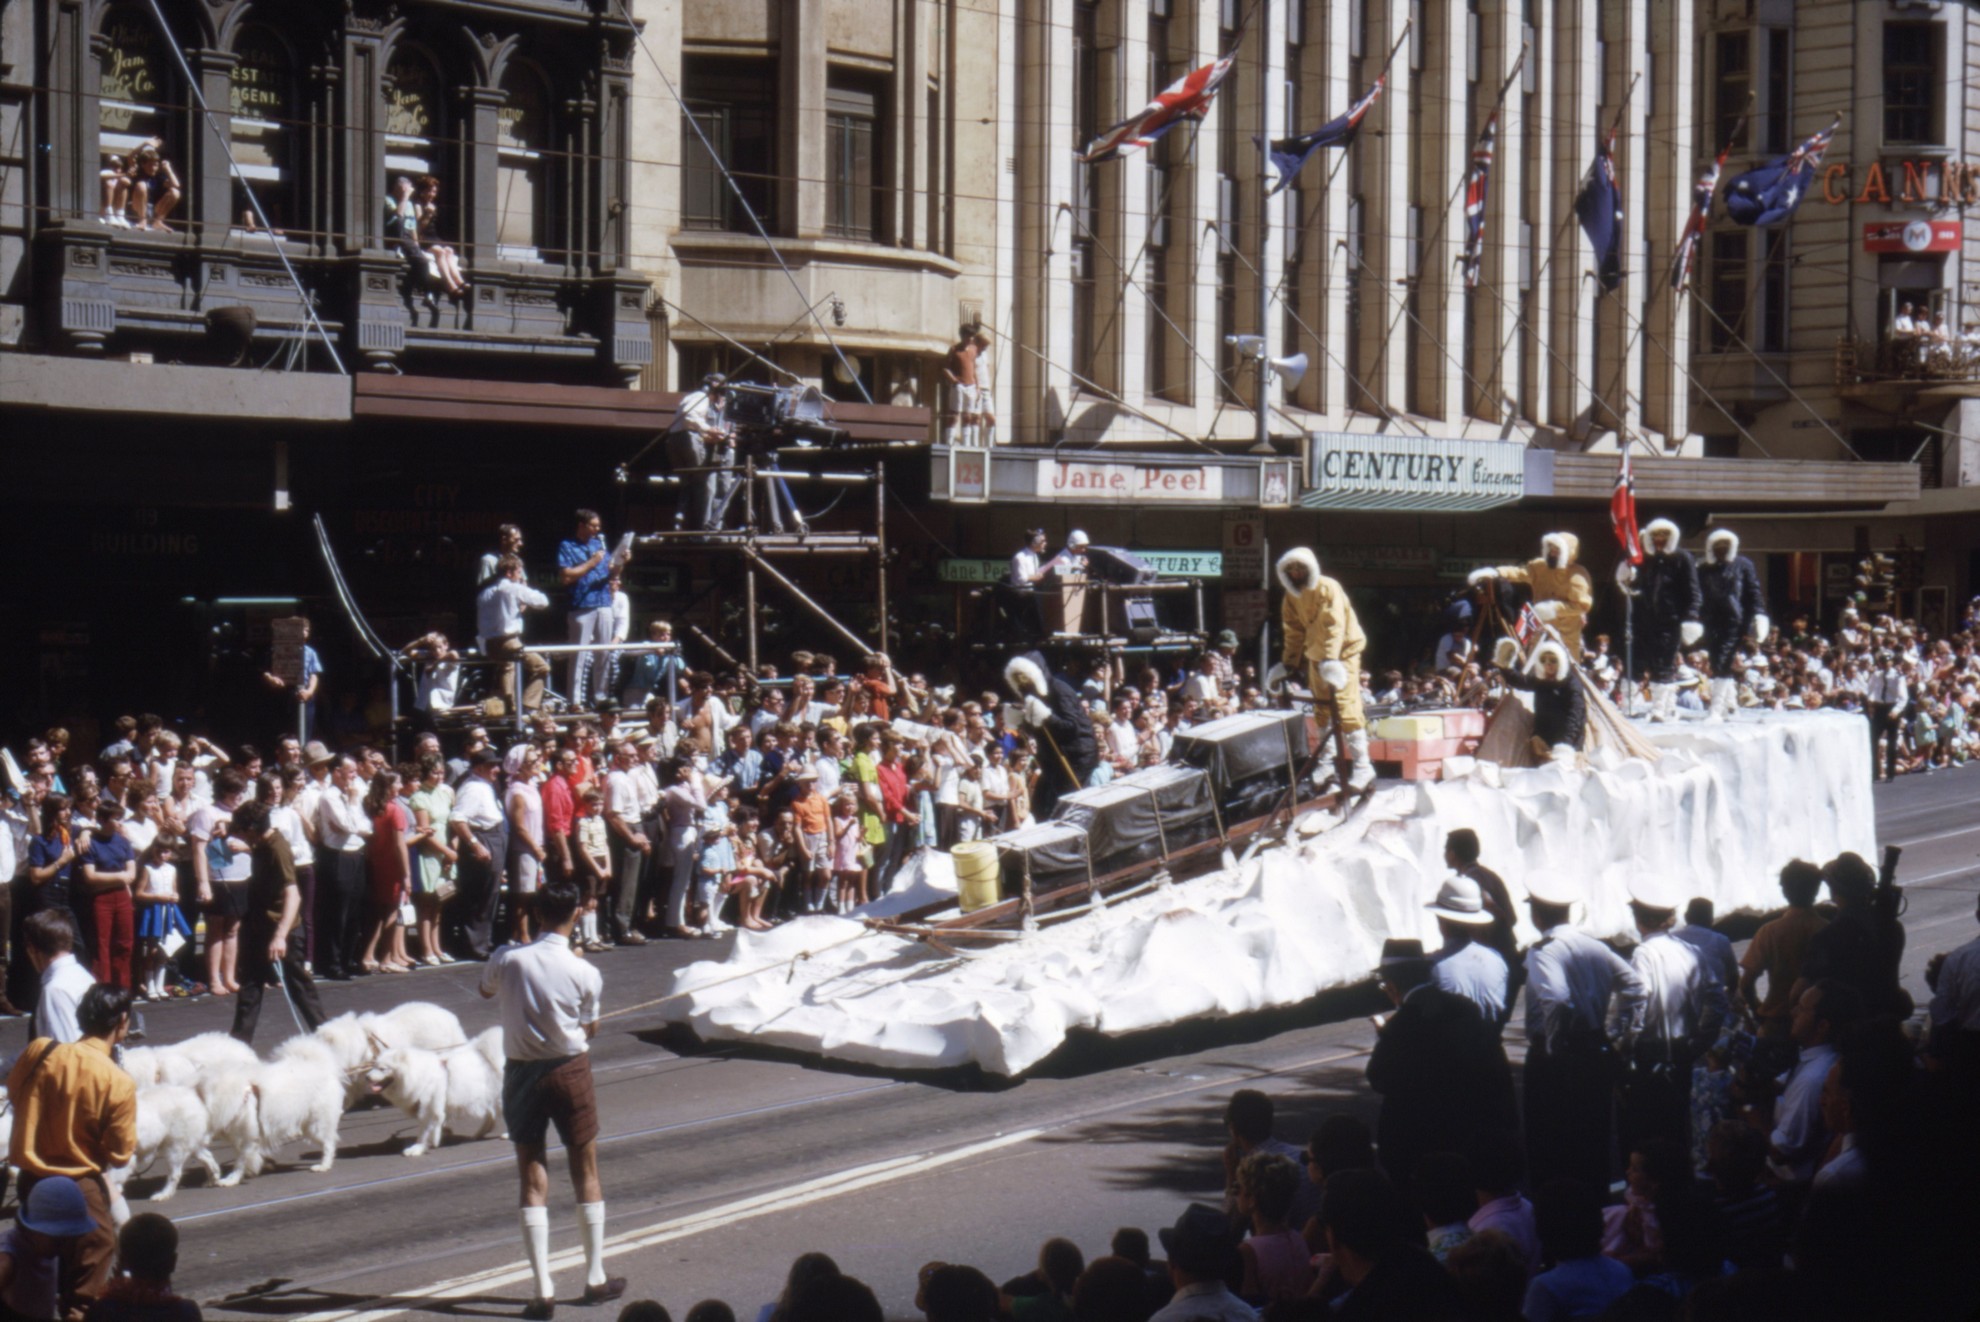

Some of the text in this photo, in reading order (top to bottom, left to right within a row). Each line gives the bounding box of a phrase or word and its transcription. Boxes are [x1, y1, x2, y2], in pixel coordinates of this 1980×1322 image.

[956, 463, 983, 484] 123
[1052, 463, 1207, 490] Jane Peel
[1324, 450, 1523, 485] CENTURY Cinema
[91, 533, 199, 555] BUILDING
[939, 560, 1009, 580] Jane Pee
[1143, 557, 1202, 572] NTURY
